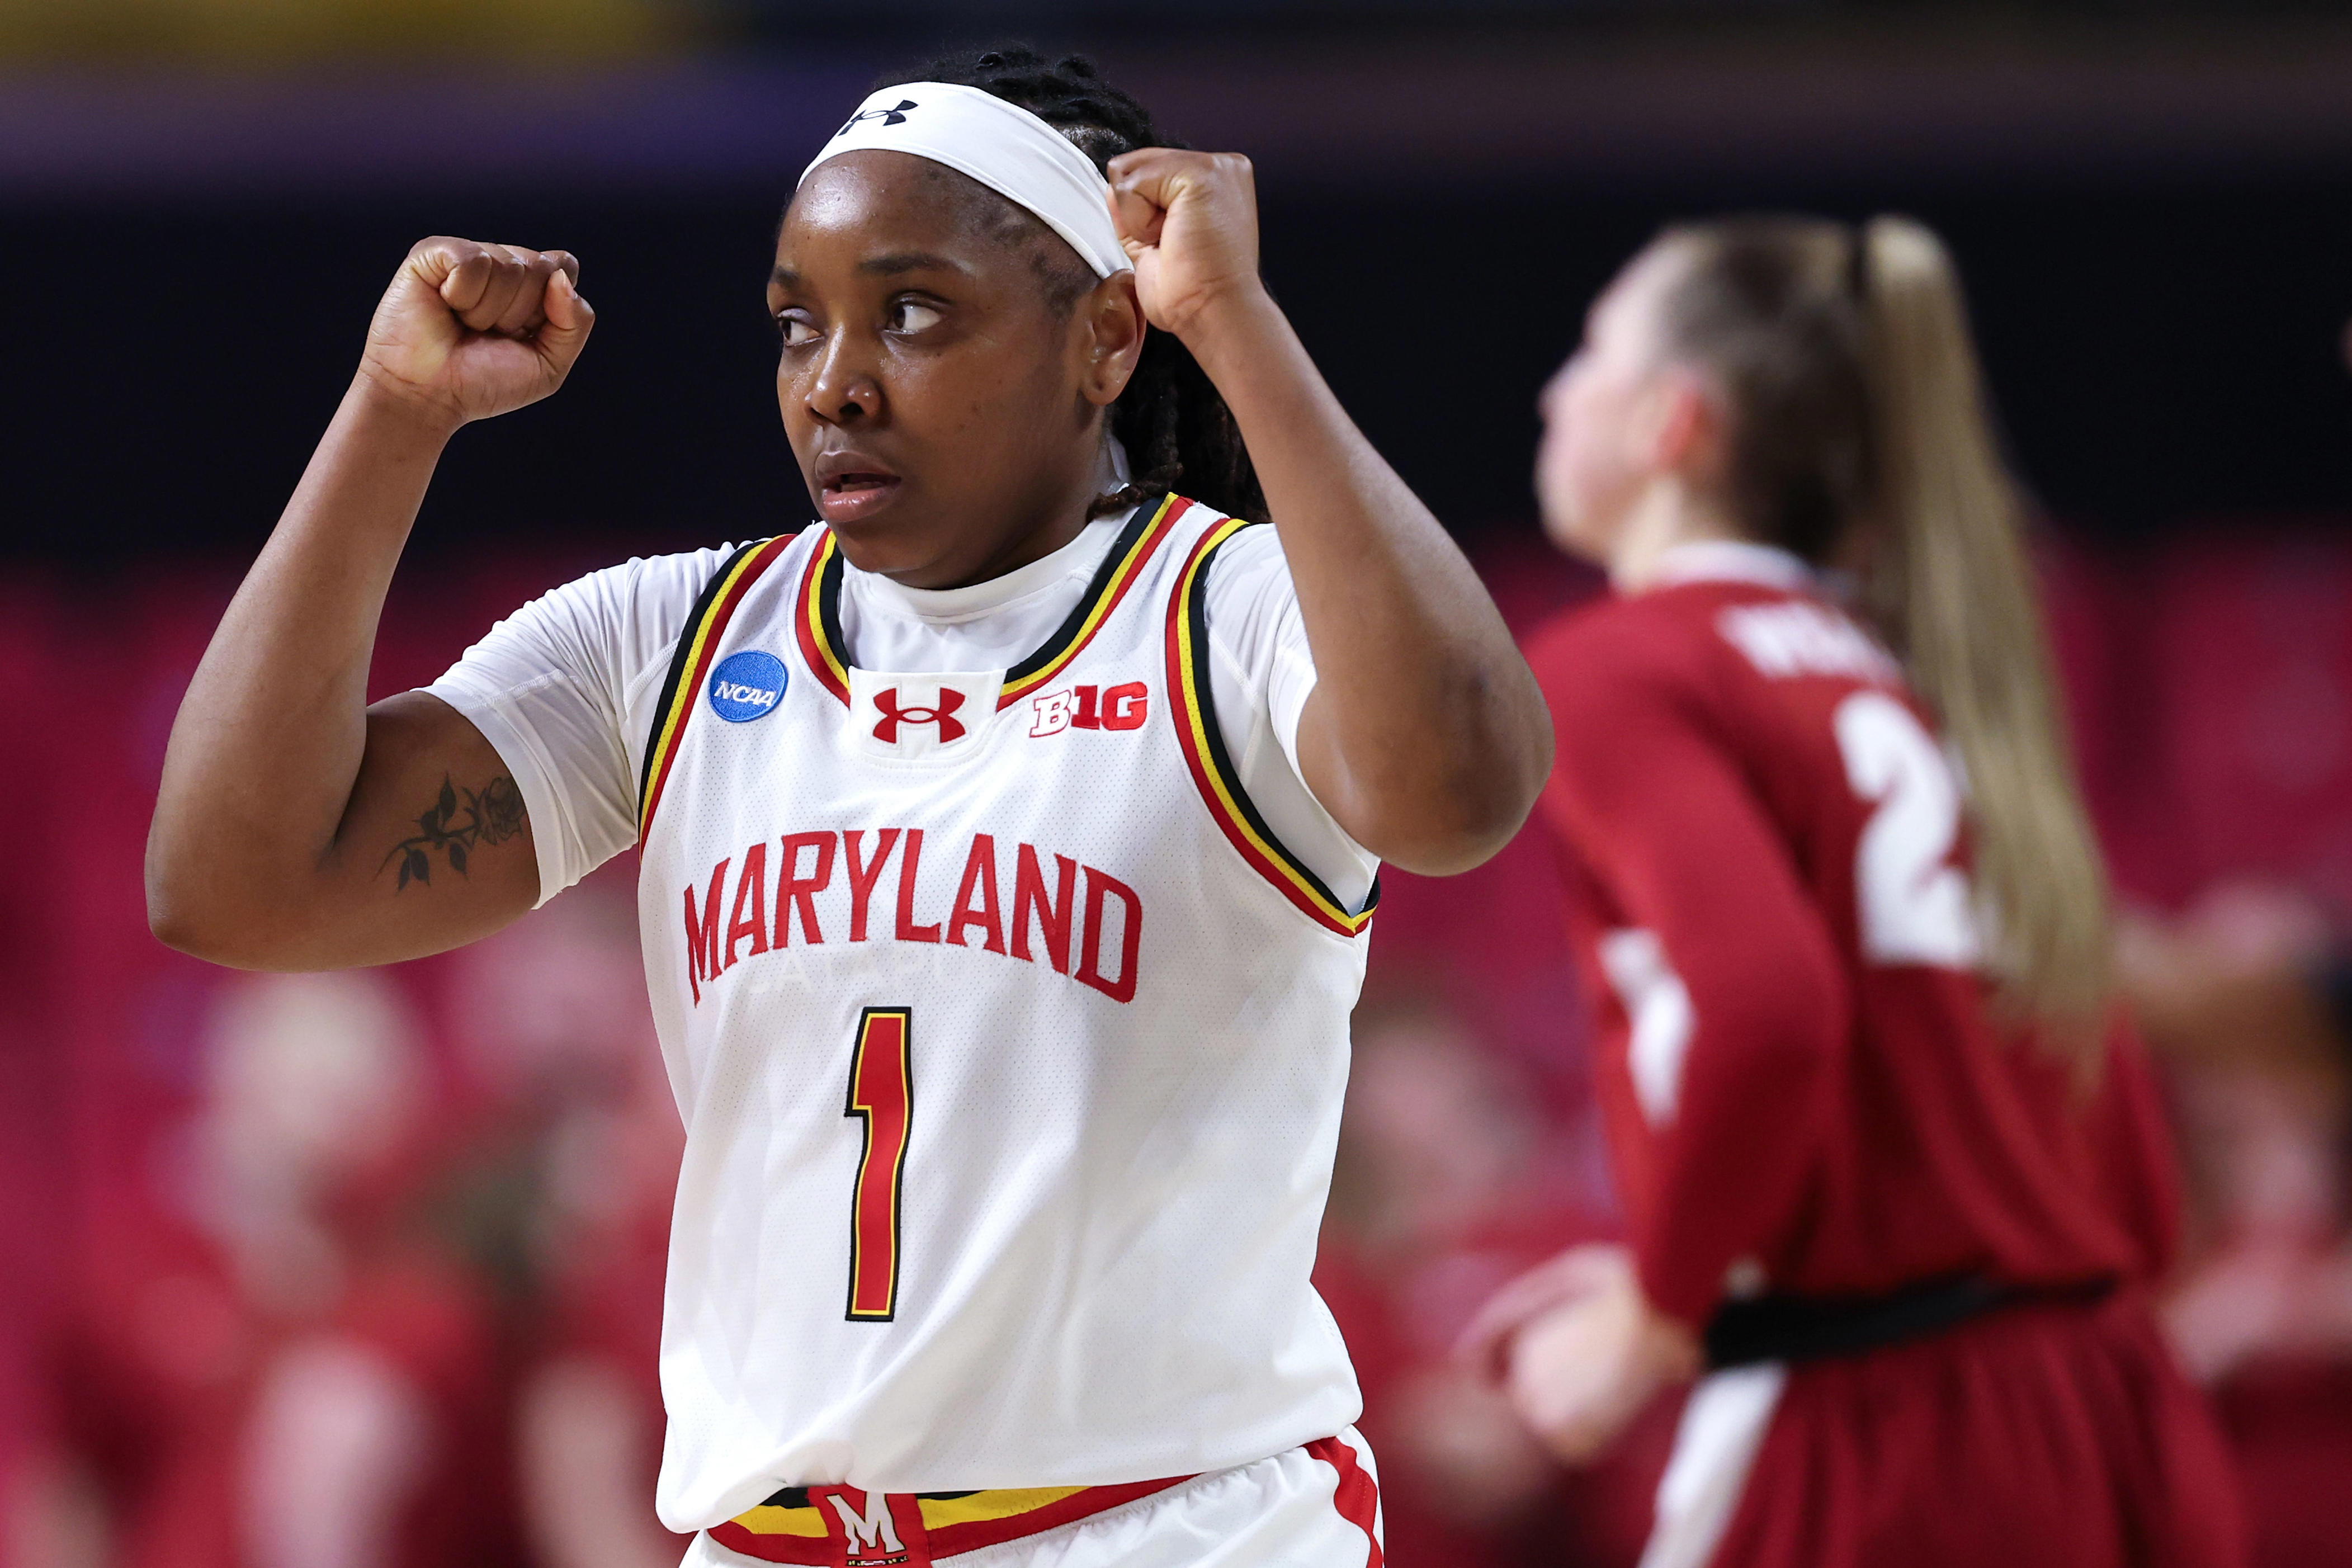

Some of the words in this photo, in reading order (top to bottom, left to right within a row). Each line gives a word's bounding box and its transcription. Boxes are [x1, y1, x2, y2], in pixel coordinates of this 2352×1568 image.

[714, 680, 776, 707] NCAA
[684, 828, 1142, 1008] MARYLAND
[1834, 691, 1974, 969] 2
[844, 1006, 914, 1322] 1
[825, 1491, 906, 1556] M
